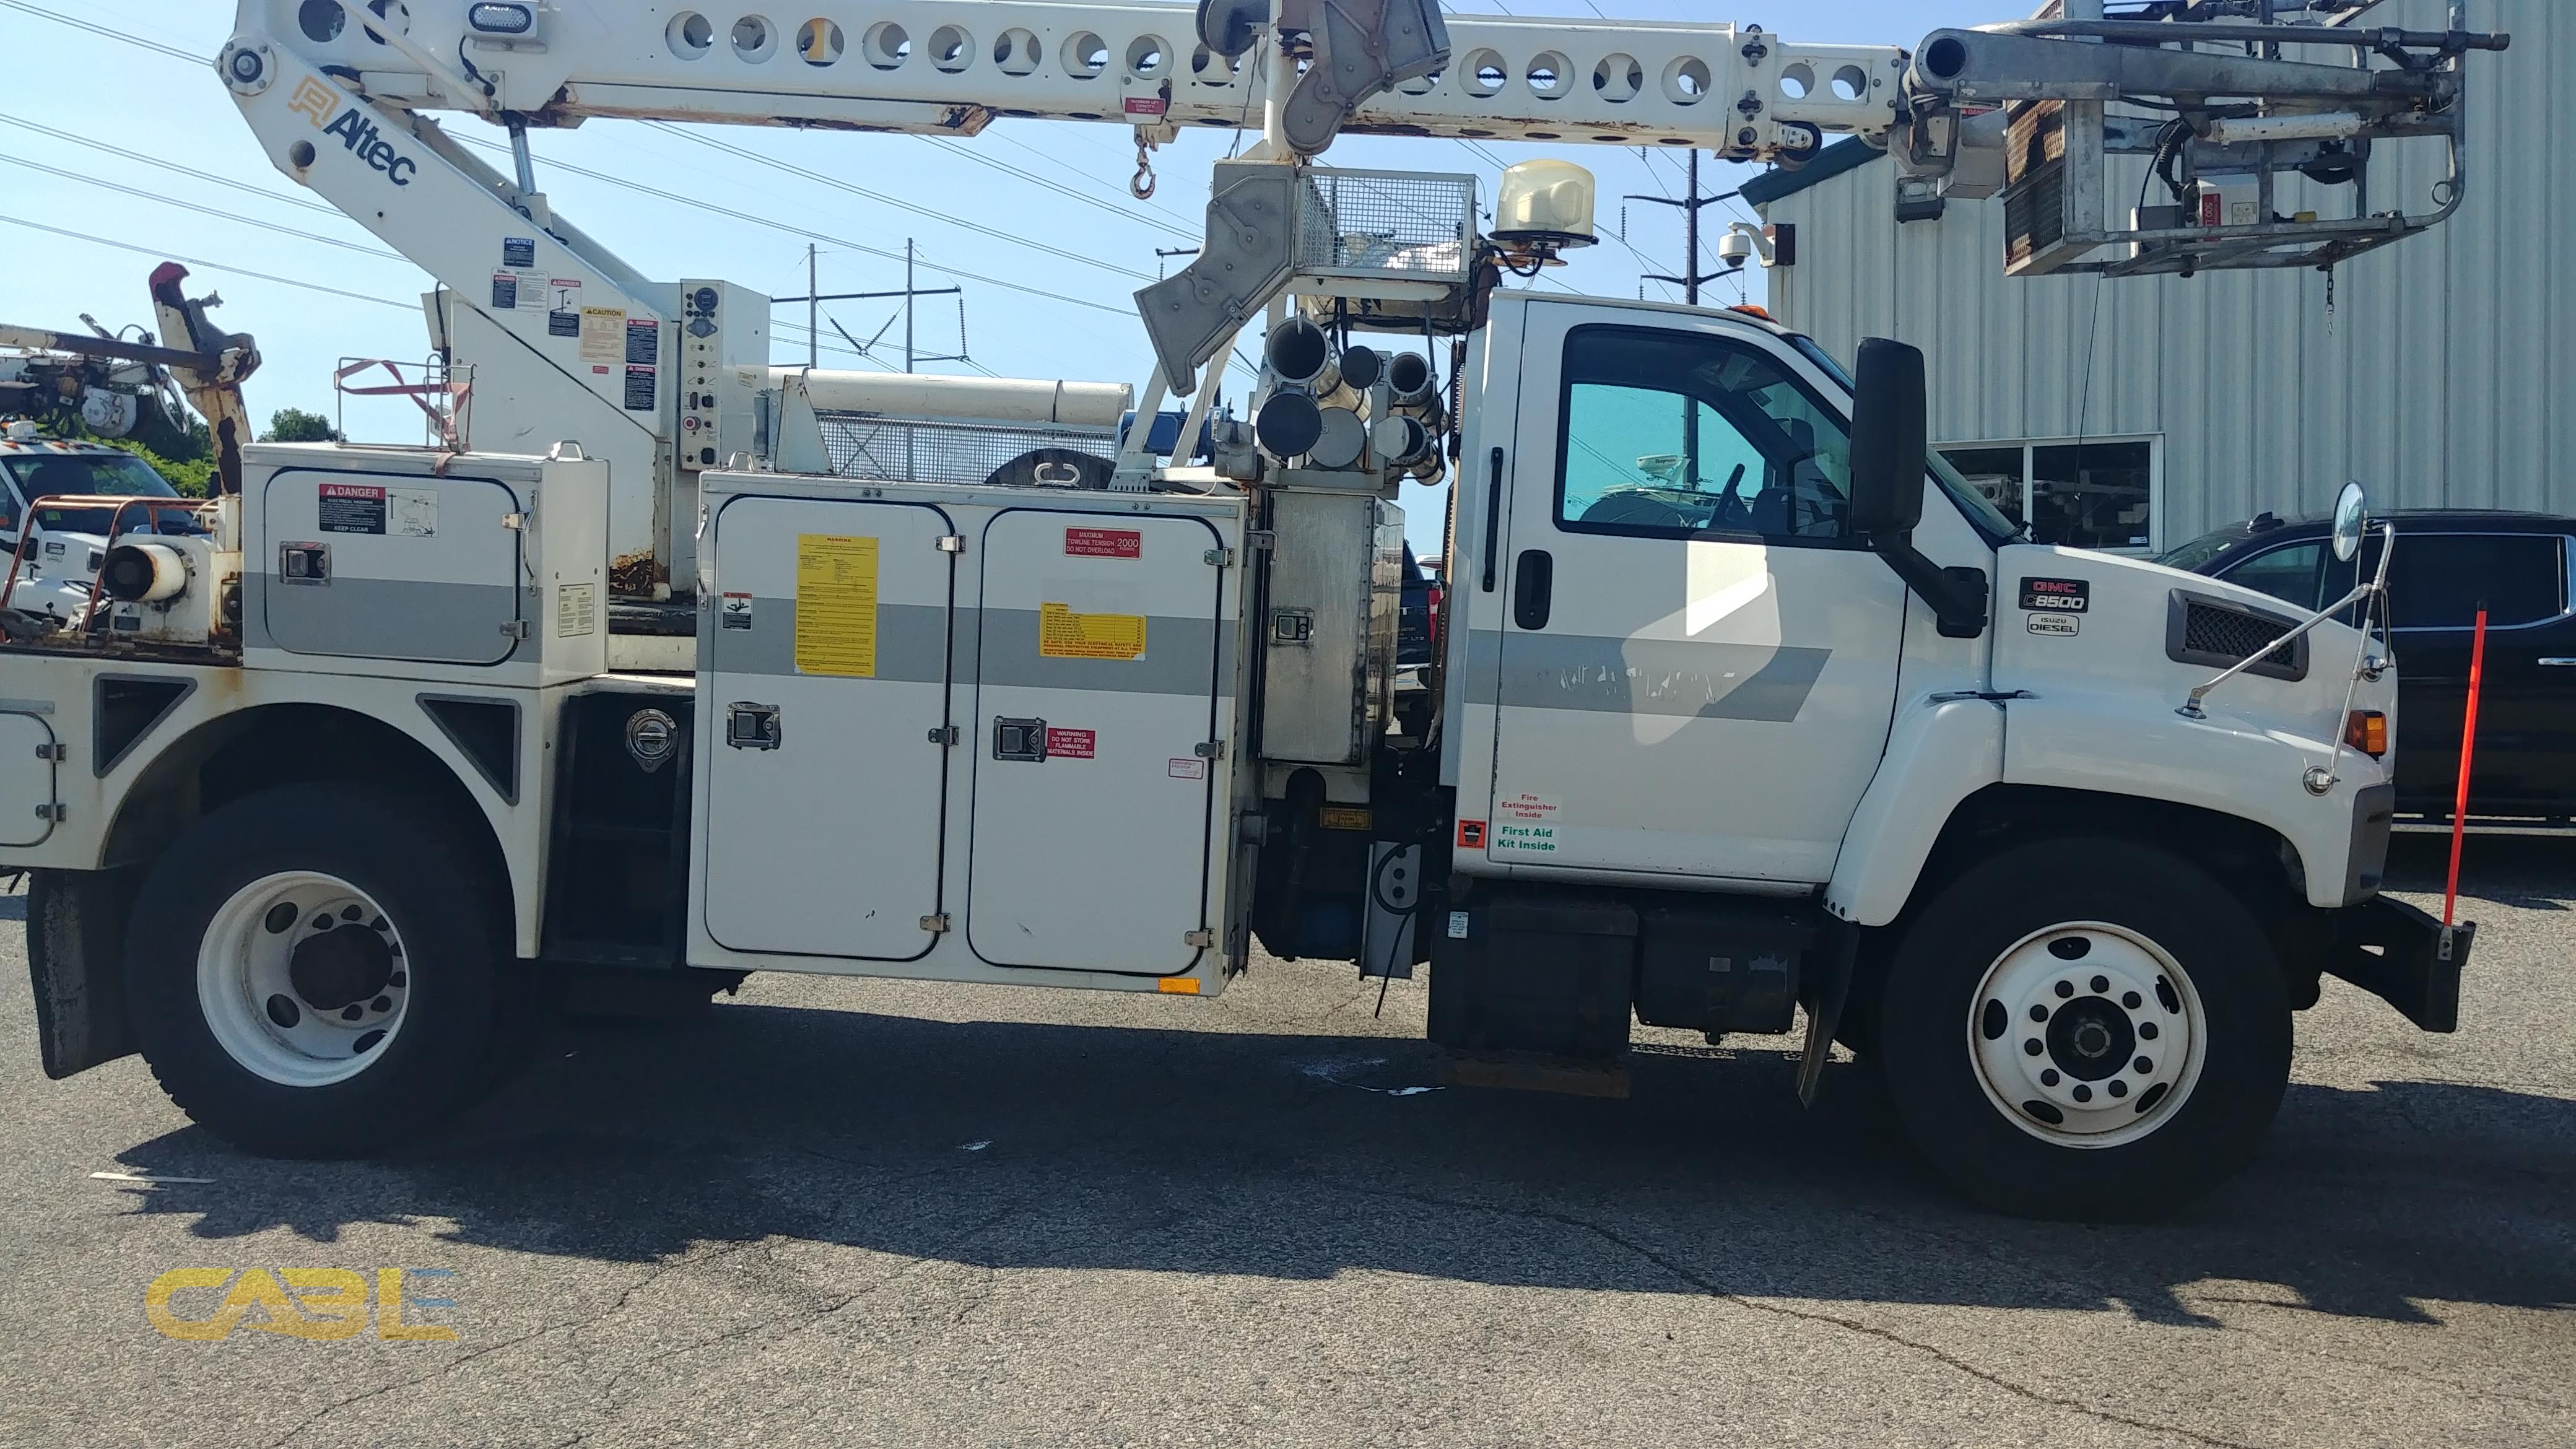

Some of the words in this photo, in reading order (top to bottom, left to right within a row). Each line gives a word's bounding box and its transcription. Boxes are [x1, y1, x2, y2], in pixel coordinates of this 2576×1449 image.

[323, 108, 416, 186] Altec
[2205, 202, 2213, 217] 500
[337, 487, 378, 498] DANGER
[1117, 538, 1139, 548] 2000
[2033, 581, 2077, 593] GMC
[2023, 594, 2085, 609] C8500
[2030, 624, 2076, 633] DIESEL
[1502, 801, 1557, 811] Extinguisher
[1502, 826, 1530, 836] First
[1533, 828, 1553, 838] Aid
[1498, 838, 1515, 848] Kit
[1519, 840, 1556, 851] Inside
